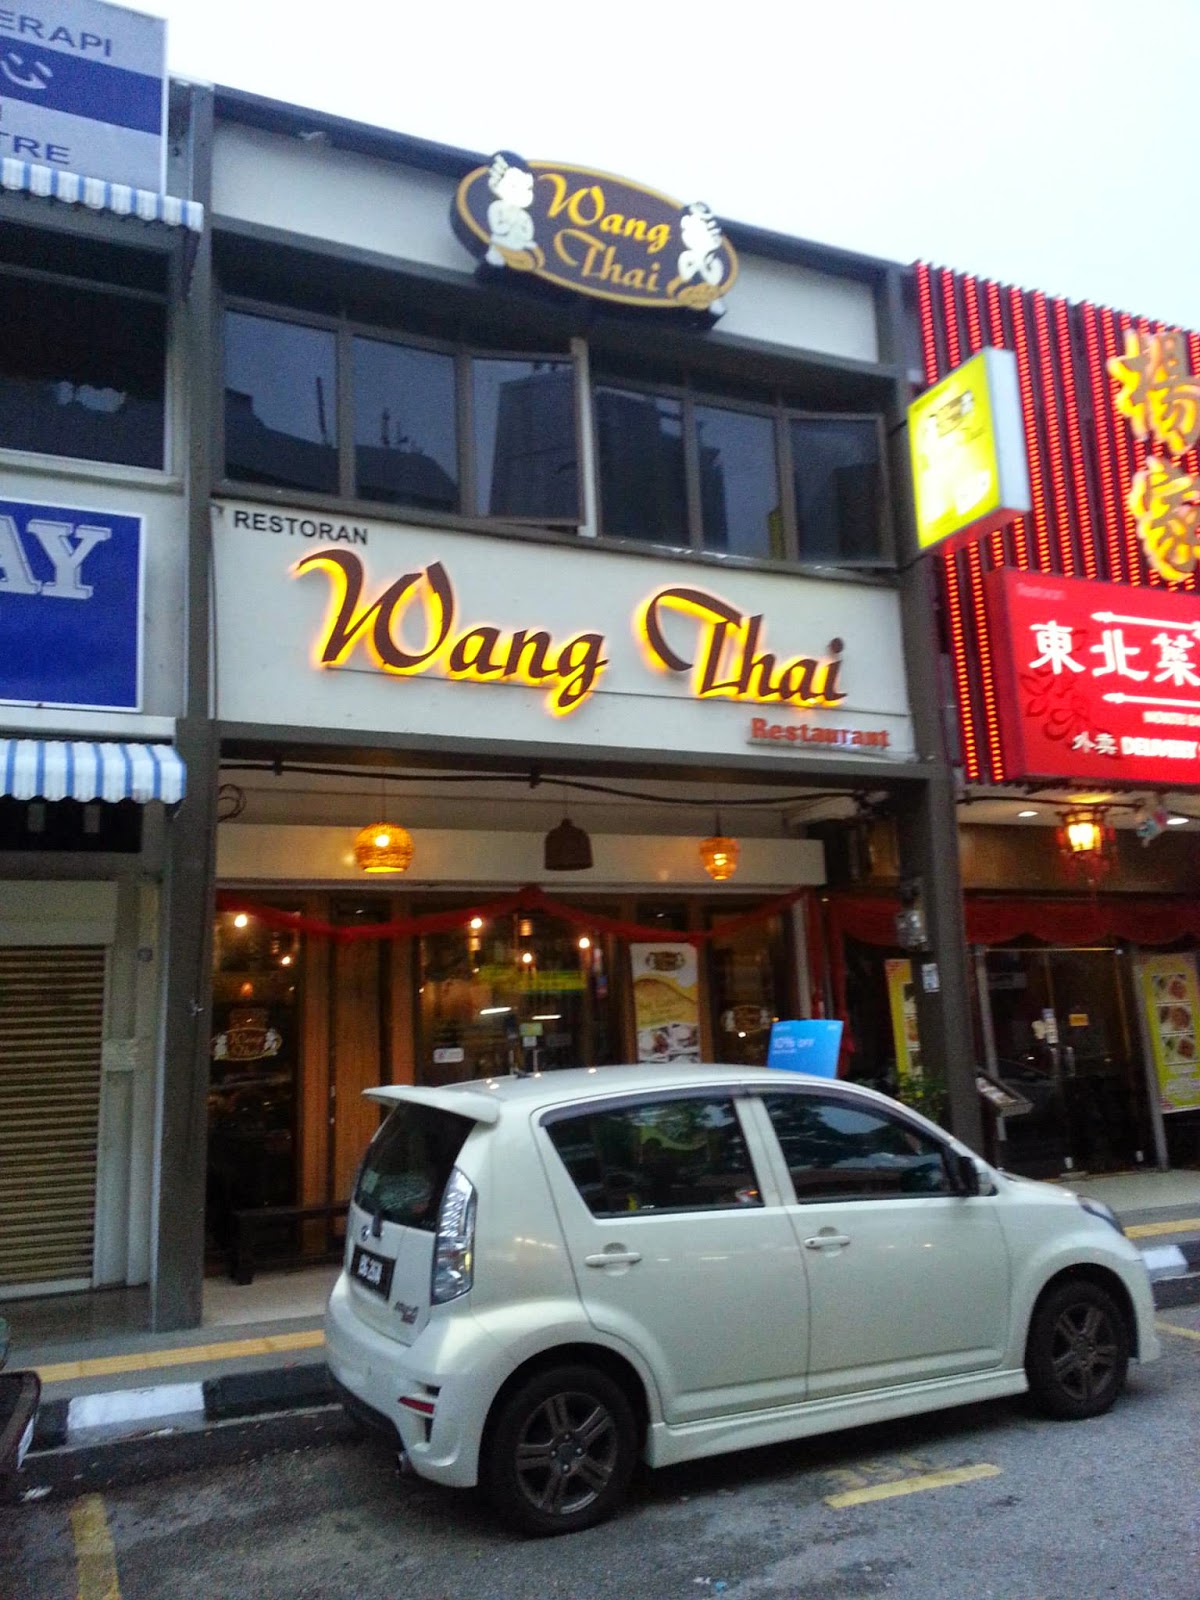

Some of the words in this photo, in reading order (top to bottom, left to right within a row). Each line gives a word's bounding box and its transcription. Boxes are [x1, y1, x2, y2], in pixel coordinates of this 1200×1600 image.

[537, 173, 671, 253] Wang
[554, 228, 661, 293] Thai
[234, 510, 368, 546] RESTORAN
[294, 549, 609, 714] Wang
[641, 587, 848, 706] Thai
[751, 717, 892, 749] Restaurant
